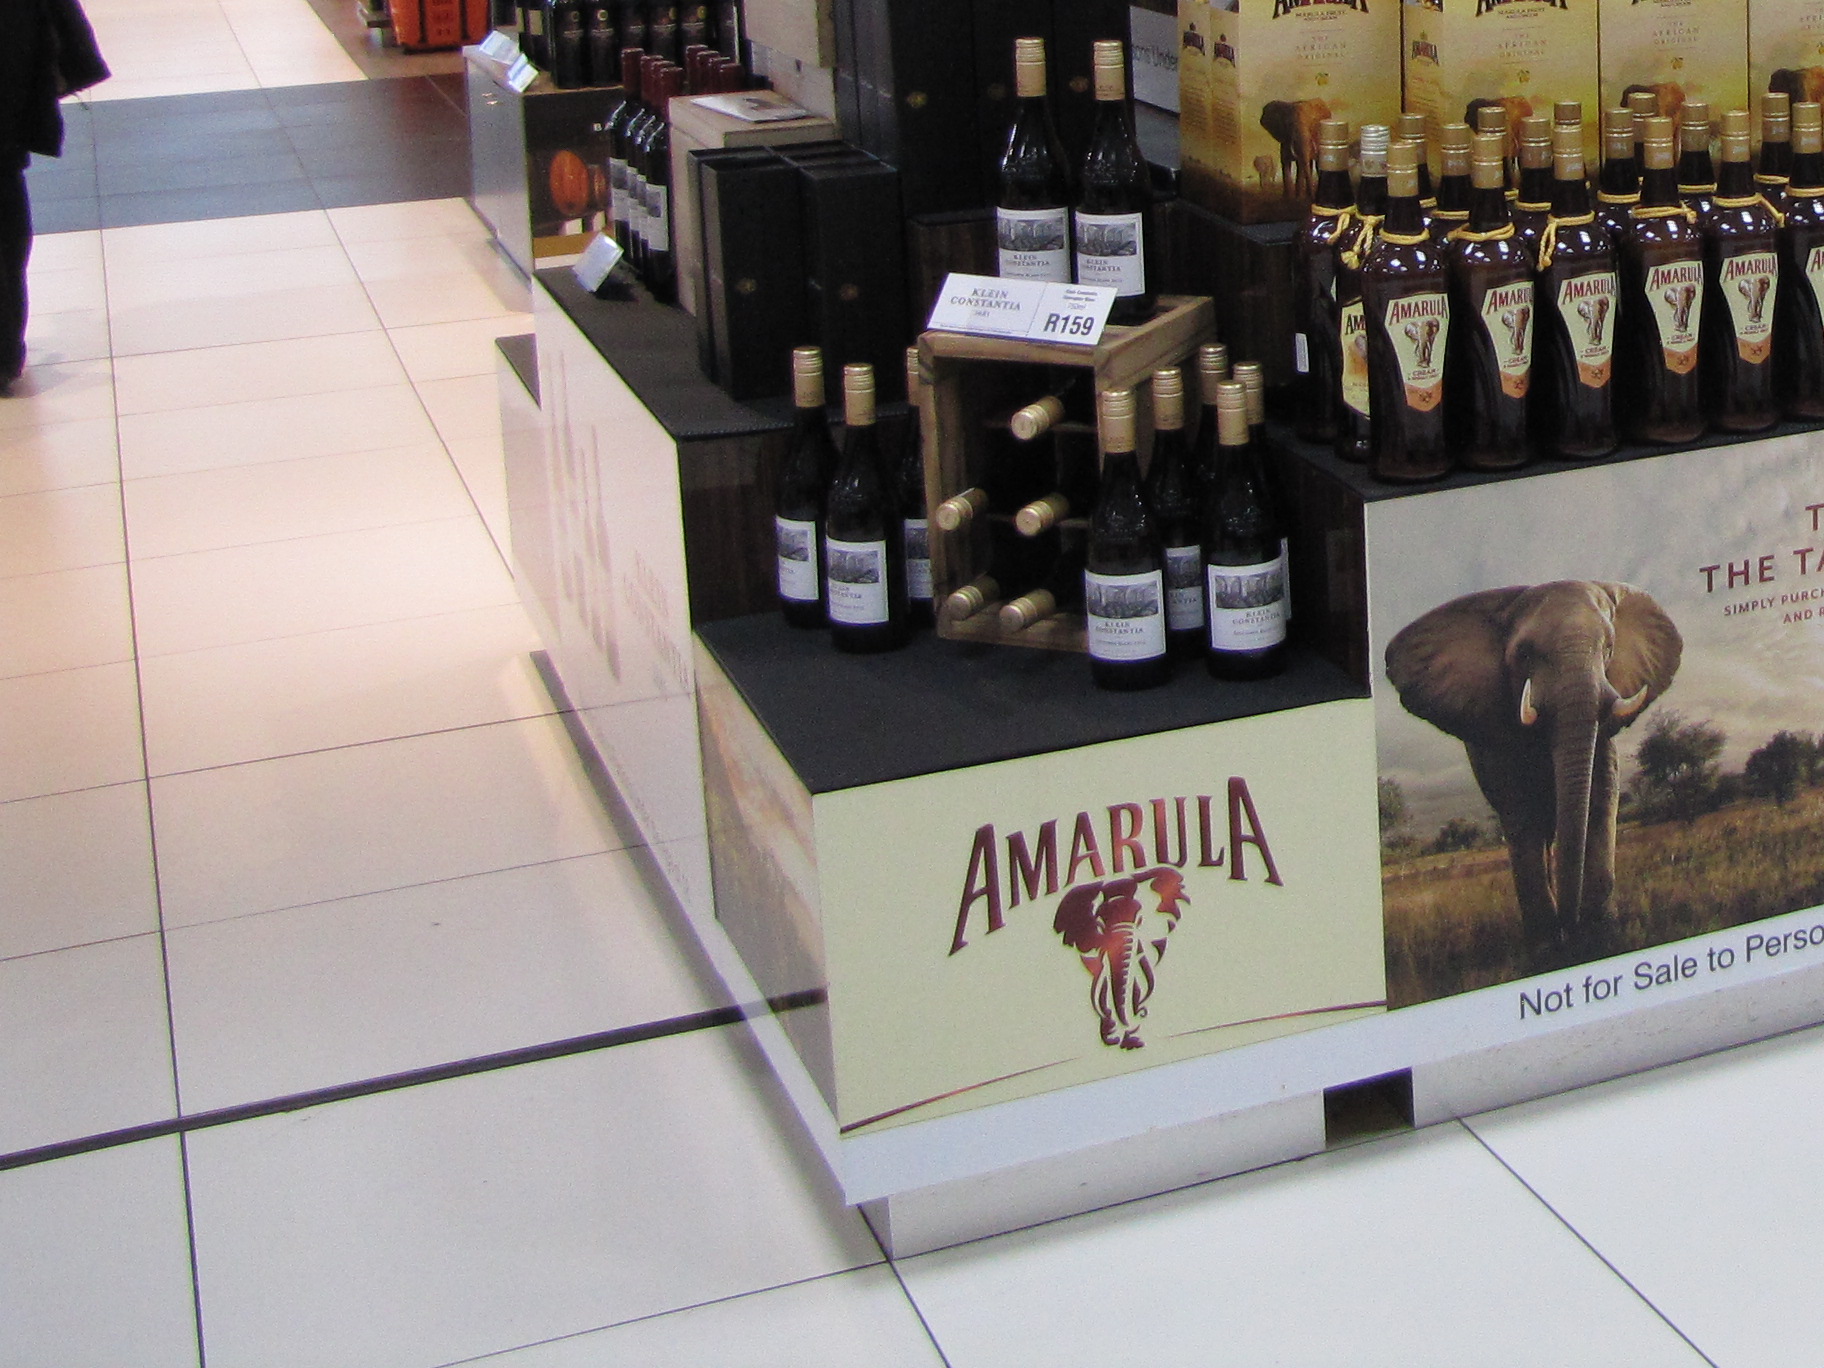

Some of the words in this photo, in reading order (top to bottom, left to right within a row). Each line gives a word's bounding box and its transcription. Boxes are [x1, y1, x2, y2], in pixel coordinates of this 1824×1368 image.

[1725, 254, 1778, 281] AMARULA
[971, 287, 1009, 299] KLEIN
[1562, 274, 1617, 305] AMARULA
[950, 296, 1021, 311] CONSTANTIA
[1389, 295, 1449, 325] AMARULA
[1043, 313, 1095, 336] R159
[1699, 554, 1776, 593] THE
[1724, 596, 1776, 617] SIMPLY
[1783, 609, 1814, 624] AND
[947, 775, 1284, 957] AMARULA
[1519, 984, 1574, 1019] Not
[1583, 974, 1623, 1003] for
[1634, 955, 1698, 991] Sale
[1707, 946, 1734, 972] to
